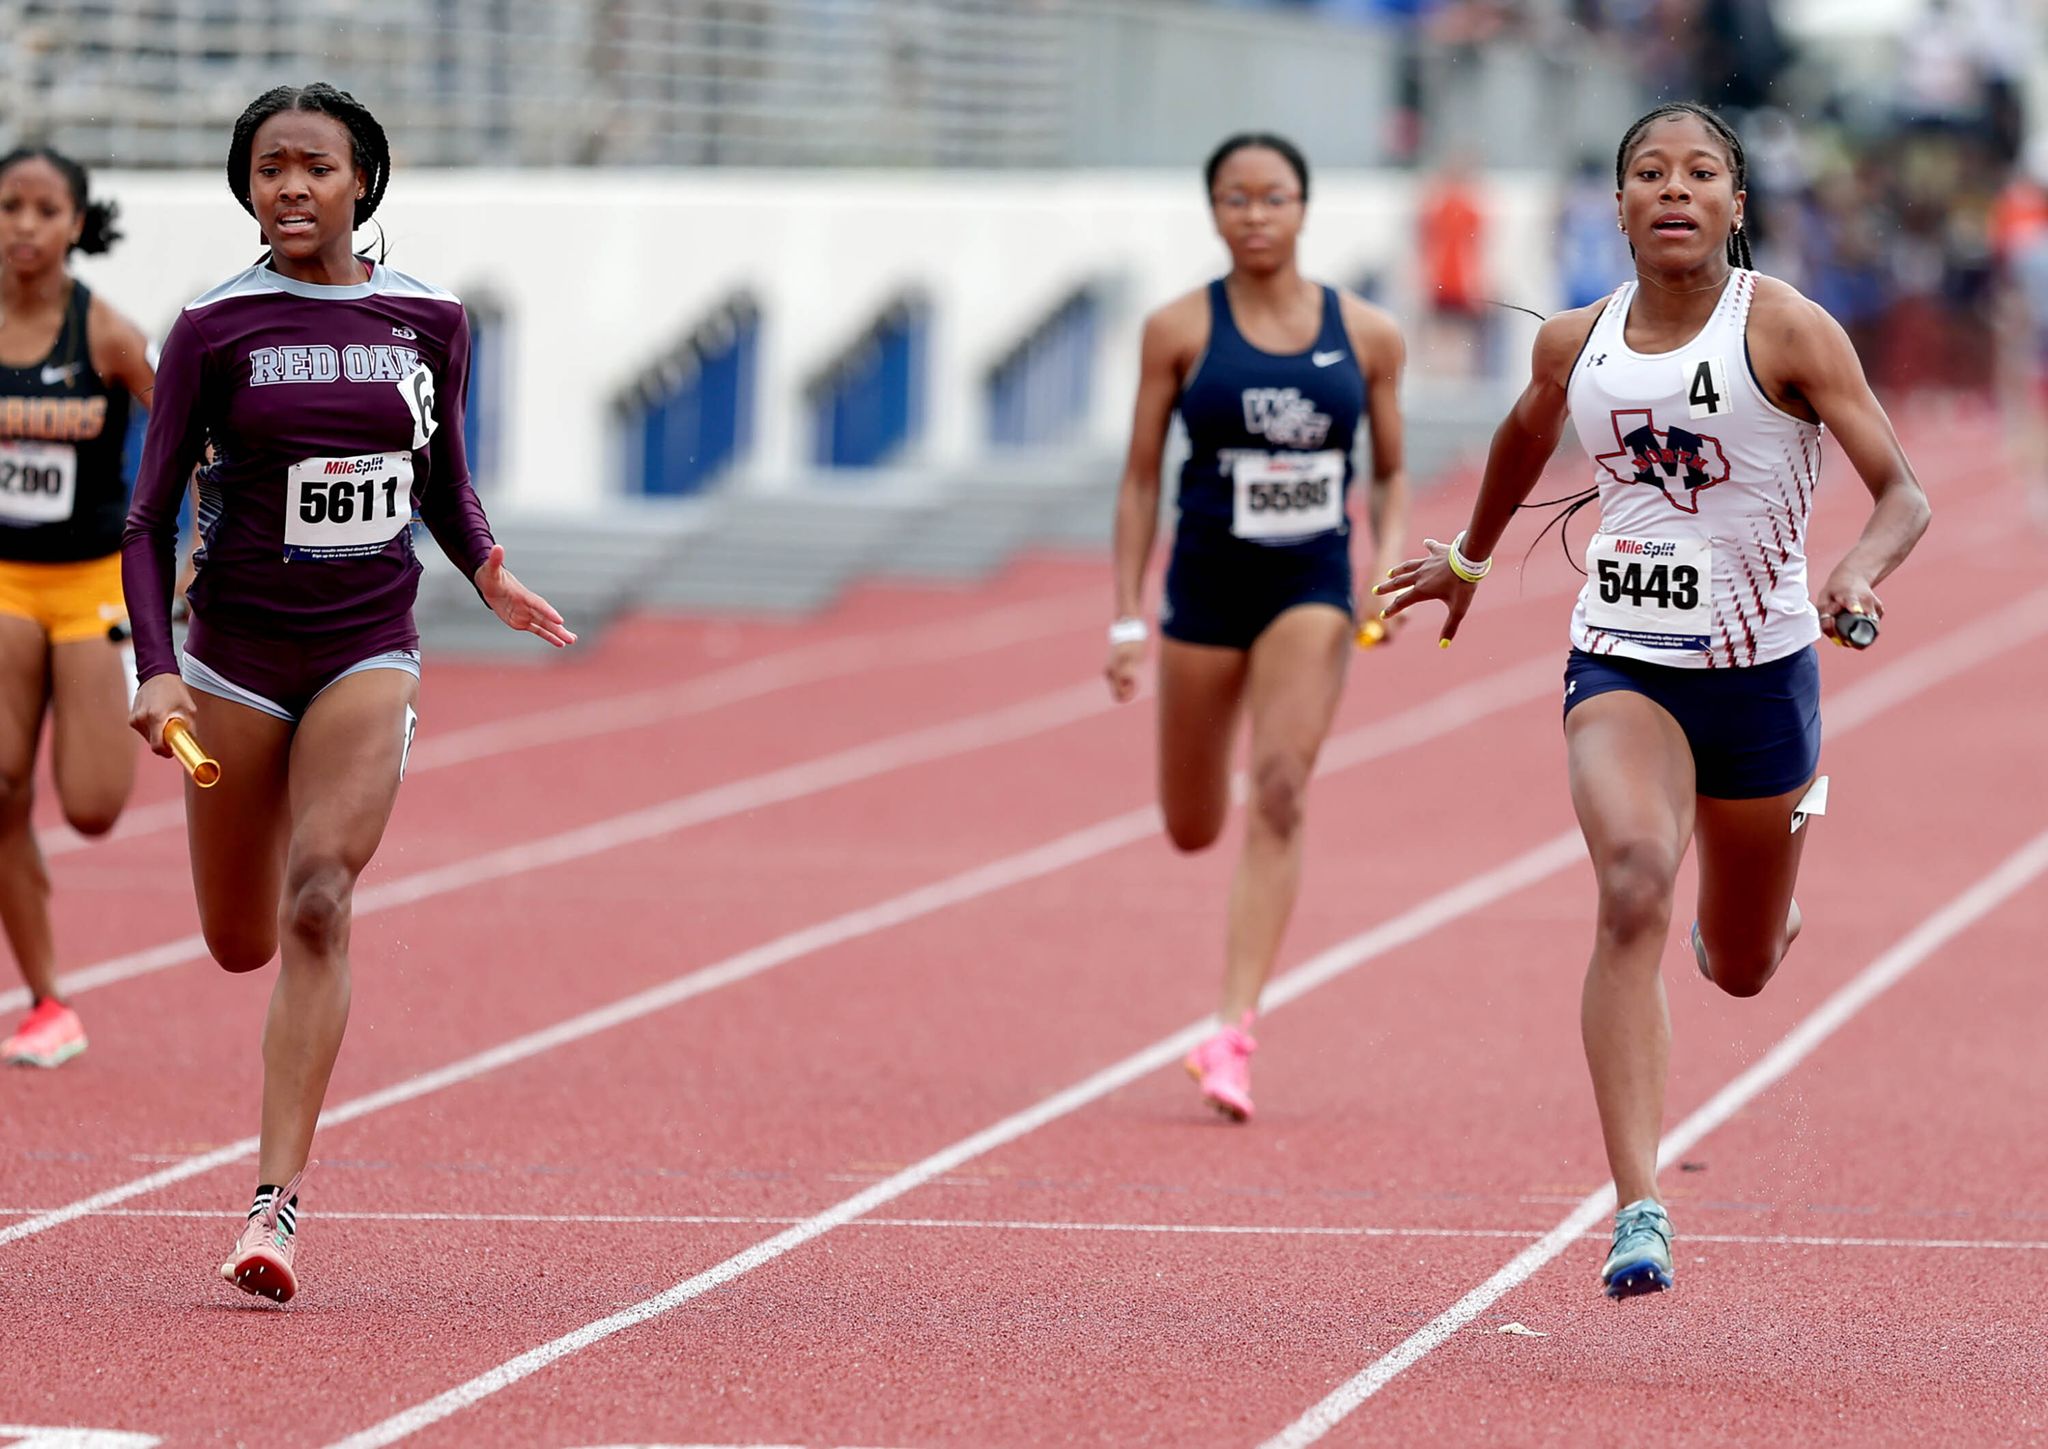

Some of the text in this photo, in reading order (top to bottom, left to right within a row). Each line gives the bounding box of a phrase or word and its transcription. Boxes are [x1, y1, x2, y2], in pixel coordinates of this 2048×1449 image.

[250, 345, 420, 386] RED OAK
[1689, 361, 1720, 414] 4
[324, 456, 384, 475] MileSplit
[1632, 448, 1708, 473] NORTH
[299, 476, 398, 524] 5611
[1615, 539, 1676, 558] MileSplit
[1597, 559, 1699, 610] 5443
